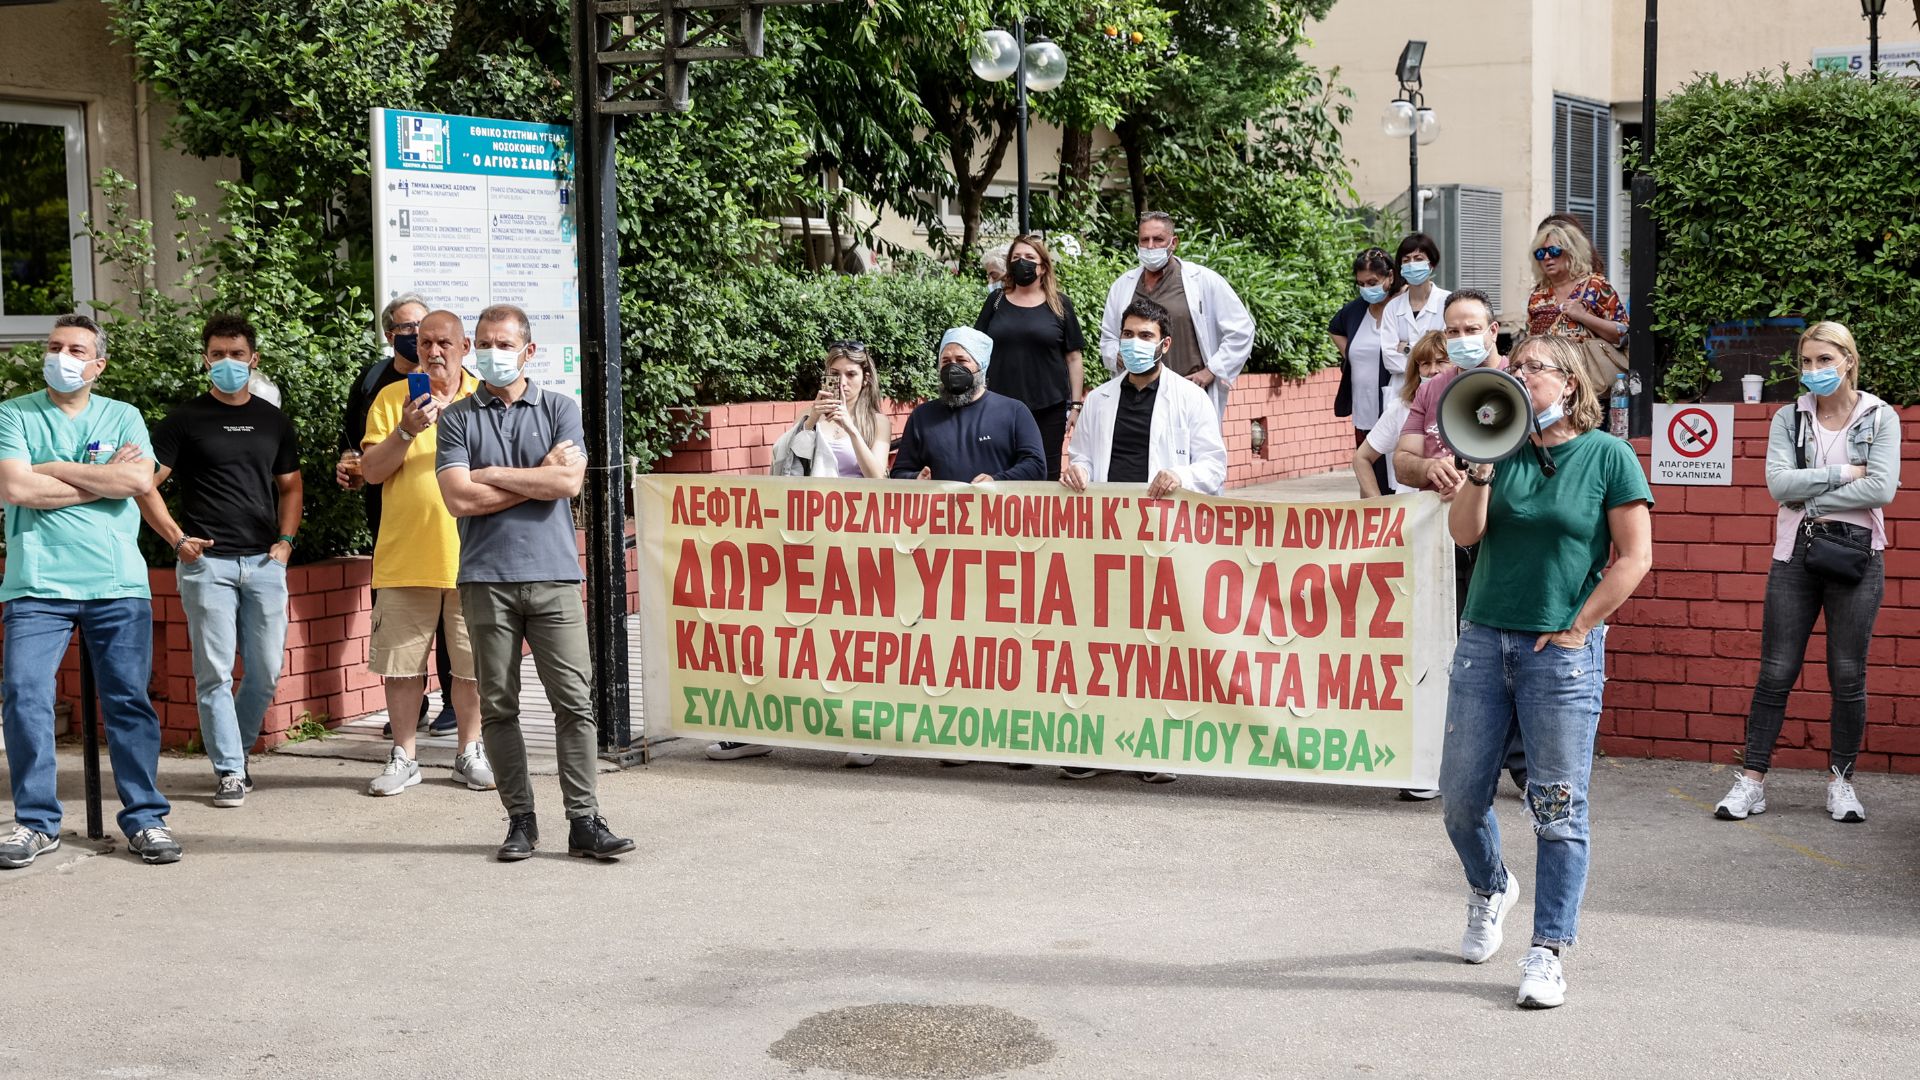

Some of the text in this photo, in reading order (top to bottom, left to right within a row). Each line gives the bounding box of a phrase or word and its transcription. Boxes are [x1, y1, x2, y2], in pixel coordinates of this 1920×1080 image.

[1852, 56, 1862, 70] 5
[470, 126, 564, 142] ΕΘΝΙΚΟ ΣΥΣΤΗΜΑ ΥΓΕΙΑΣ
[492, 142, 544, 154] ΝΟΣΟΚΟΜΕΙΟ
[484, 155, 518, 168] ΑΓΙΟΣ
[401, 211, 407, 226] 1
[565, 348, 572, 362] 5
[1658, 460, 1726, 470] ΑΠΑΓΟΡΕΥΕΤΑΙ
[1676, 471, 1722, 480] ΚΑΠΝΙΣΜΑ
[787, 490, 974, 536] ΠΡΟΣΛΗΨΕΙΣ
[981, 494, 1093, 539] ΜΟΝΙΜΗ
[1137, 498, 1273, 548] ΣΤΑΘΕΡΗ
[1281, 507, 1405, 550] ΔΟΥΛΕΙΑ
[672, 538, 1404, 638] ΔΩΡΕΑΝ ΥΓΕΙΑ ΓΙΑ ΟΛΟΥΣ
[675, 620, 1403, 710] ΚΑΤΩ ΤΑ ΧΕΡΙΑ ΑΠΟ ΤΑ ΣΥΝΔΙΚΑΤΑ ΜΑΣ
[682, 686, 1396, 772] ΣΥΛΛΟΓΟΣ ΕΡΓΑΖΟΜΕΝΩΝ «ΑΓΙΟΥ ΣΑΒΒΑ»
